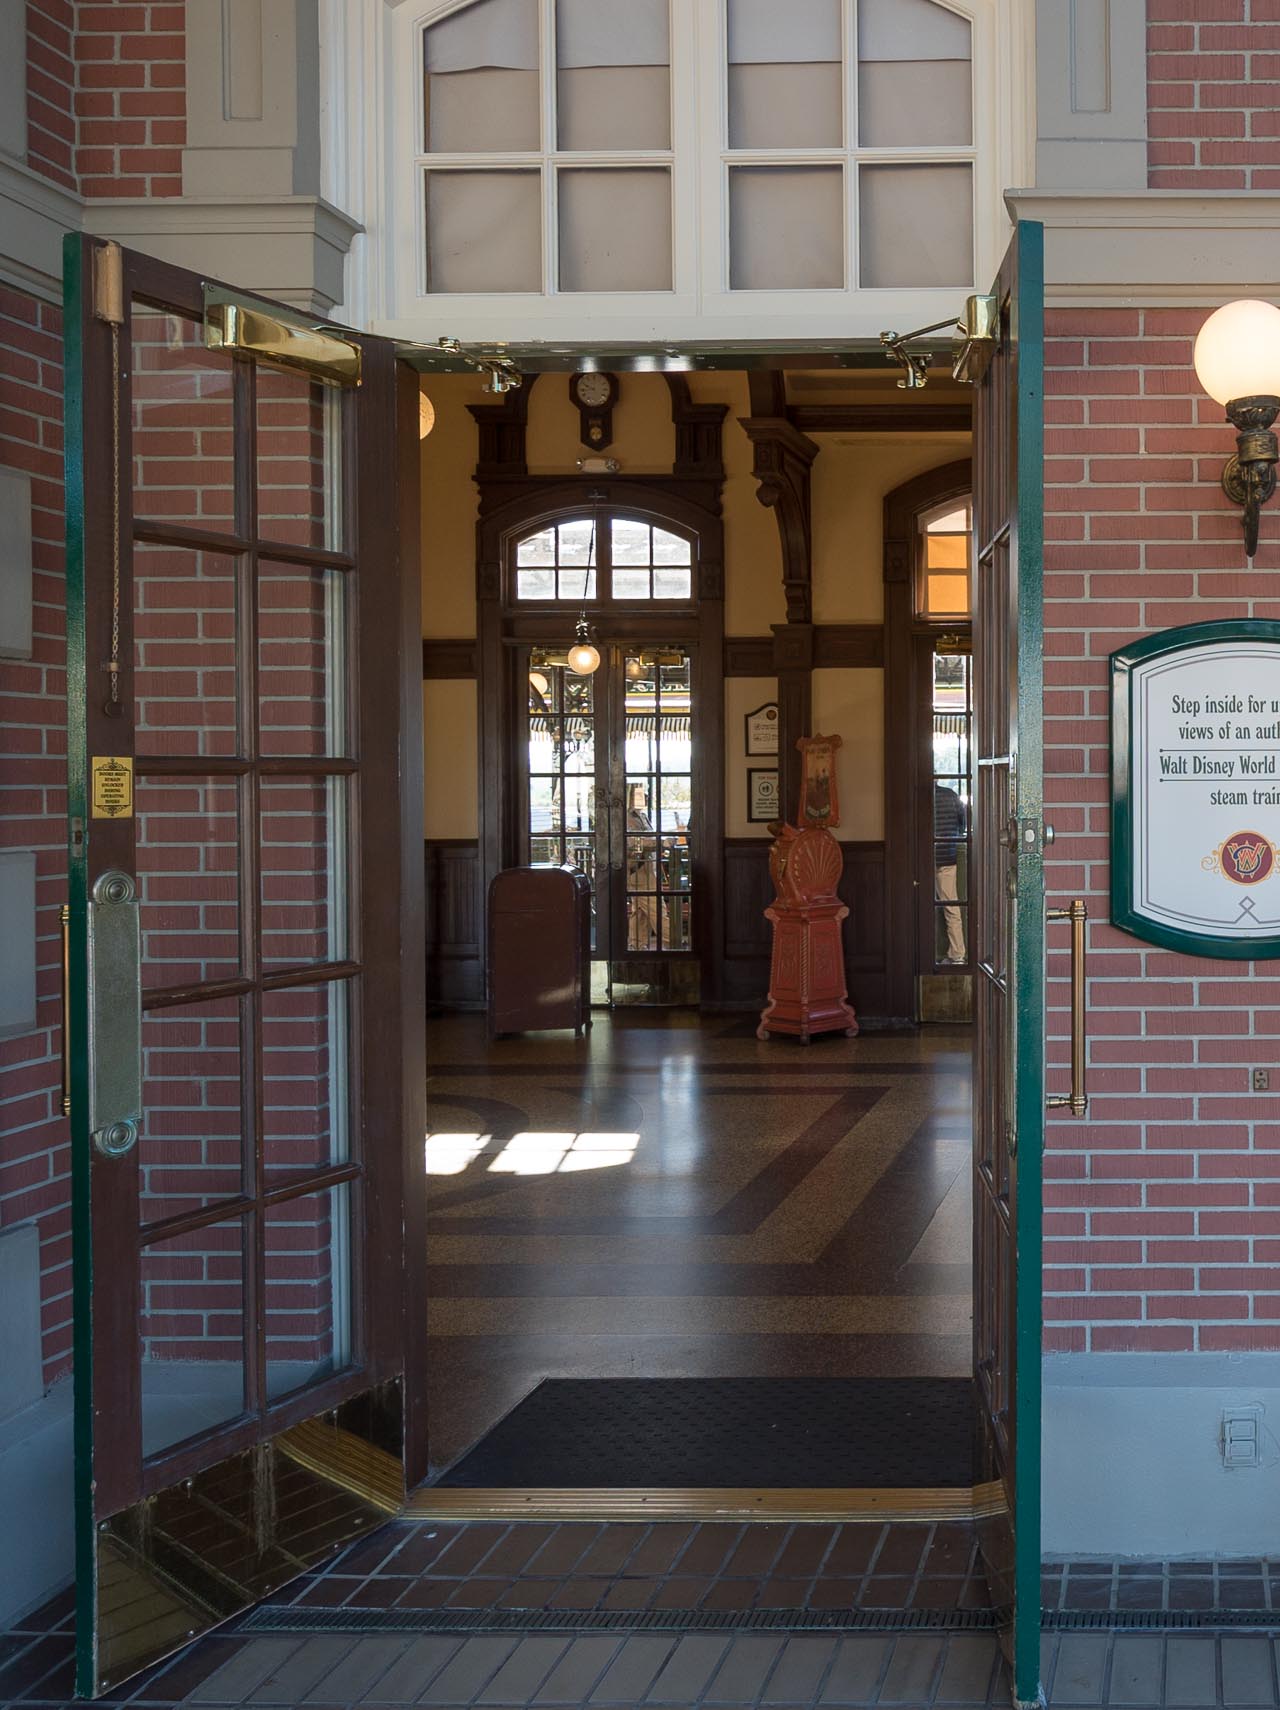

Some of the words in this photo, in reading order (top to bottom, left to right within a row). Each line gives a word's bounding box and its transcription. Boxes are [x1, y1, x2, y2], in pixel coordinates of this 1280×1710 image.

[1172, 694, 1200, 718] Step
[1205, 694, 1244, 714] inside
[1248, 694, 1267, 714] for
[1178, 721, 1214, 740] views
[1218, 720, 1232, 740] of
[1235, 725, 1251, 740] an
[1159, 755, 1188, 775] Walt
[1192, 755, 1235, 778] Disney
[1239, 755, 1276, 774] World
[1210, 788, 1248, 806] steam
